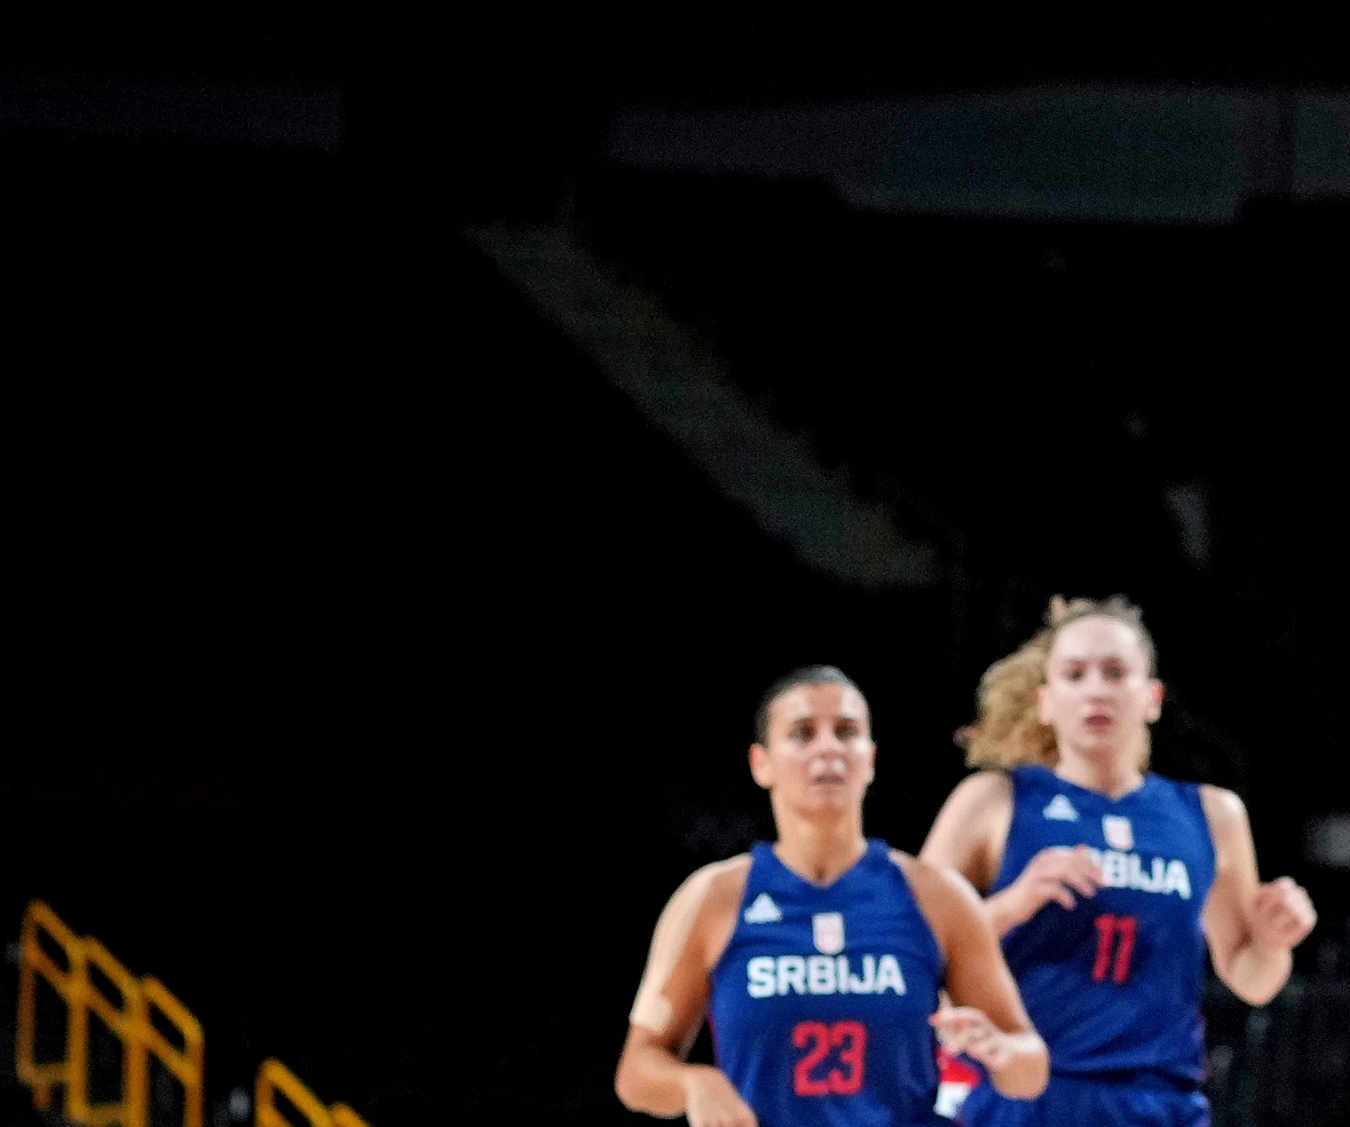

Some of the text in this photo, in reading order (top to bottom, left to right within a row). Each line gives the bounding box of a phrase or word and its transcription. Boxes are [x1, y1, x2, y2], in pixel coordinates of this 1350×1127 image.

[1086, 848, 1193, 900] BIJA
[747, 953, 907, 998] SRBIJA
[1092, 913, 1138, 984] 11
[793, 1020, 867, 1096] 23
